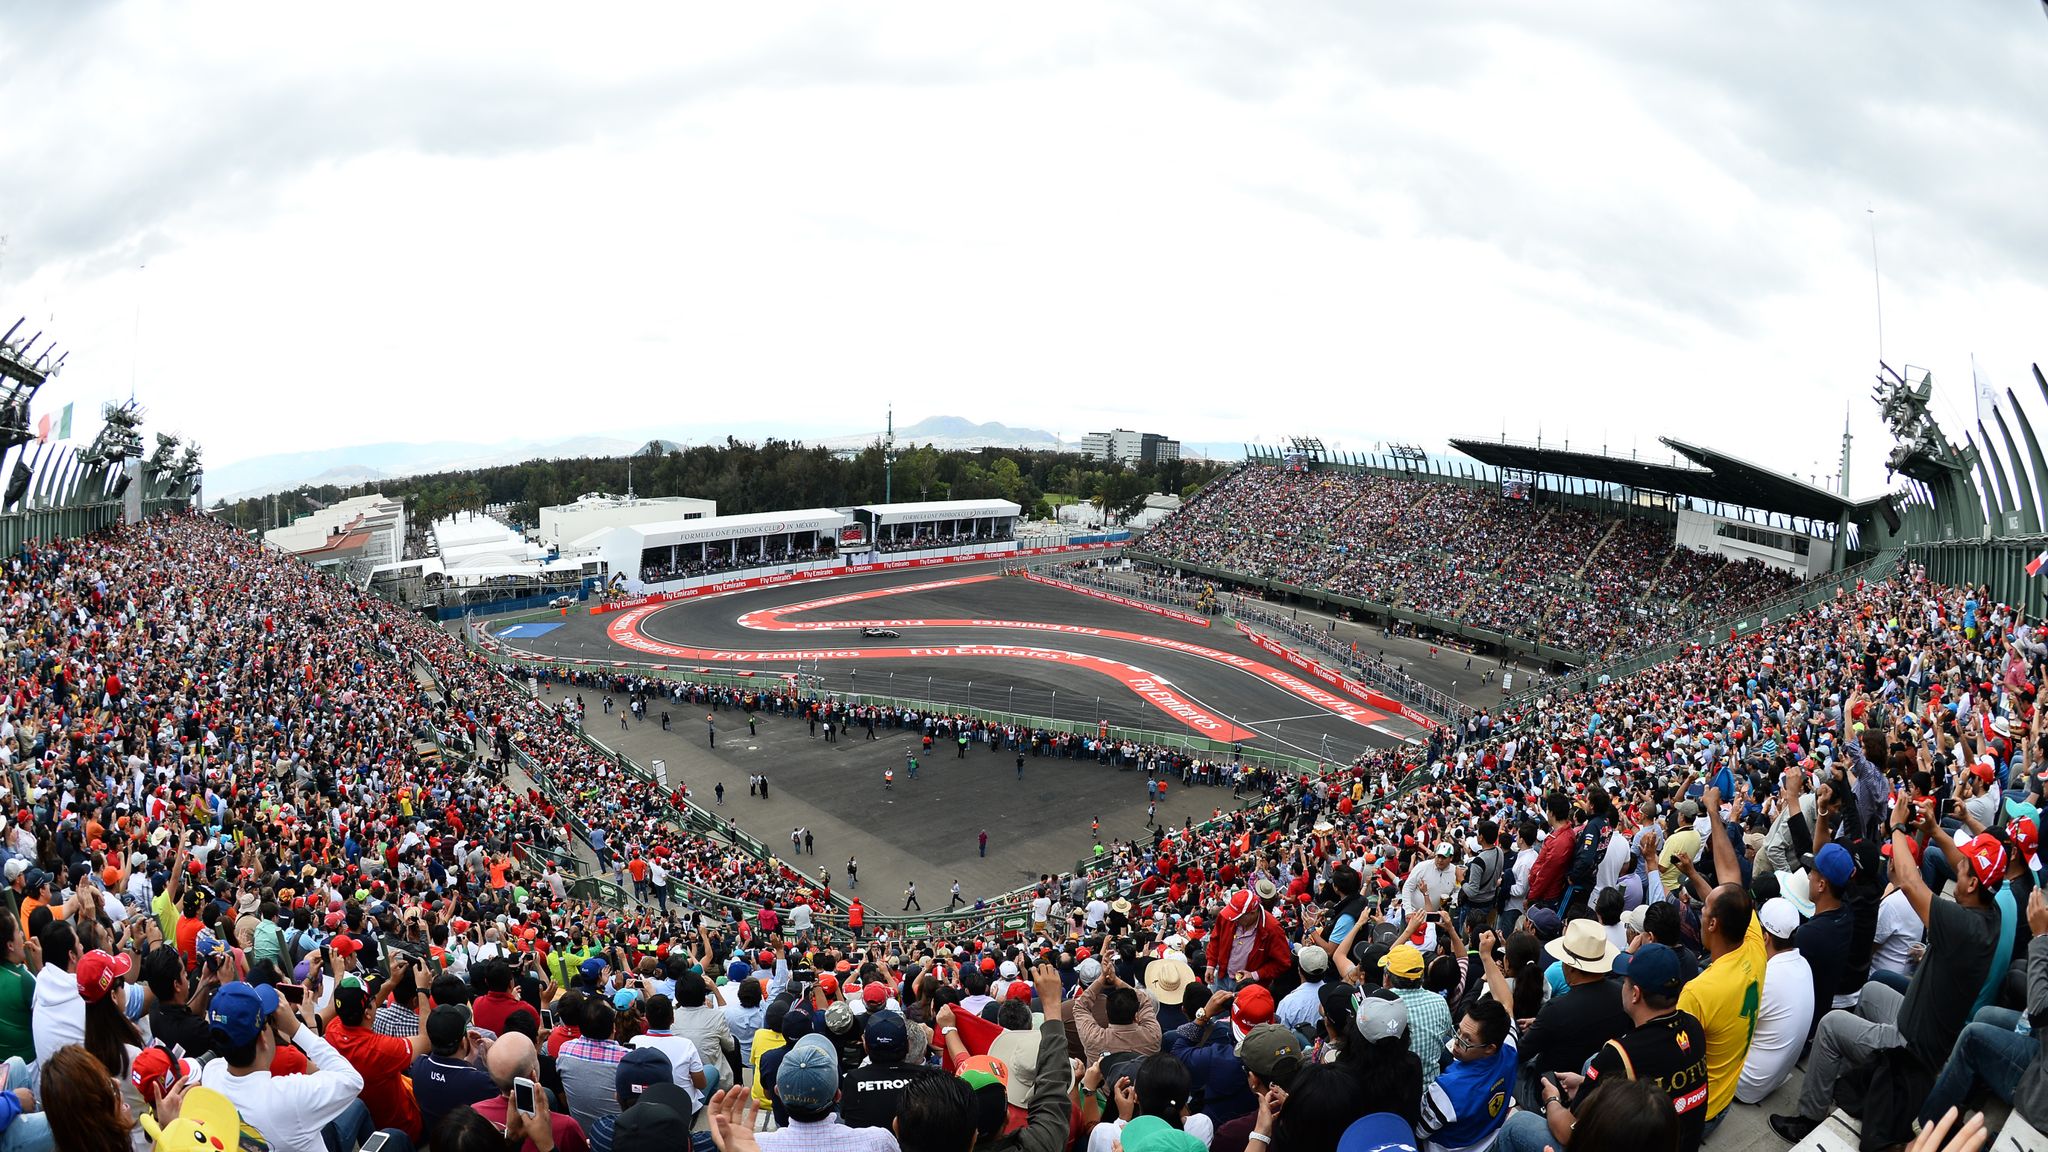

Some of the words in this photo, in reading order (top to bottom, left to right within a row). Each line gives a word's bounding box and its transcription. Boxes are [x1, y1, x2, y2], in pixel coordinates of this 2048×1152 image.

[680, 531, 714, 541] FORMULA
[715, 529, 731, 539] ONE
[731, 526, 764, 538] PADDOCK
[764, 524, 781, 533] CLUB
[795, 521, 819, 530] MÉXICO
[760, 577, 770, 585] Fly
[770, 574, 793, 583] Emirates
[804, 571, 813, 579] Fly
[813, 569, 834, 578] Emirates
[713, 584, 723, 593] Fly
[723, 581, 747, 591] Emirates
[662, 592, 674, 601] Fly
[674, 589, 699, 599] Emirates
[610, 600, 621, 610] Fly
[621, 597, 648, 608] Emirates
[1191, 616, 1206, 625] Emirates
[1139, 636, 1224, 658] Emirates
[1269, 644, 1282, 656] Emirates
[712, 652, 751, 660] Fly
[955, 648, 1060, 660] Emirates
[1220, 655, 1255, 667] Fly
[1293, 656, 1308, 669] Emirates
[1320, 669, 1337, 683] Emirates
[1267, 672, 1335, 706] Emirates
[1343, 681, 1351, 692] Fly
[1350, 685, 1369, 701] Emirates
[1129, 679, 1156, 696] Fly
[1149, 689, 1222, 730] Emirates
[1328, 700, 1366, 718] Fly
[1400, 705, 1409, 717] Fly
[1408, 710, 1426, 725] Emirates
[431, 1071, 446, 1082] USA
